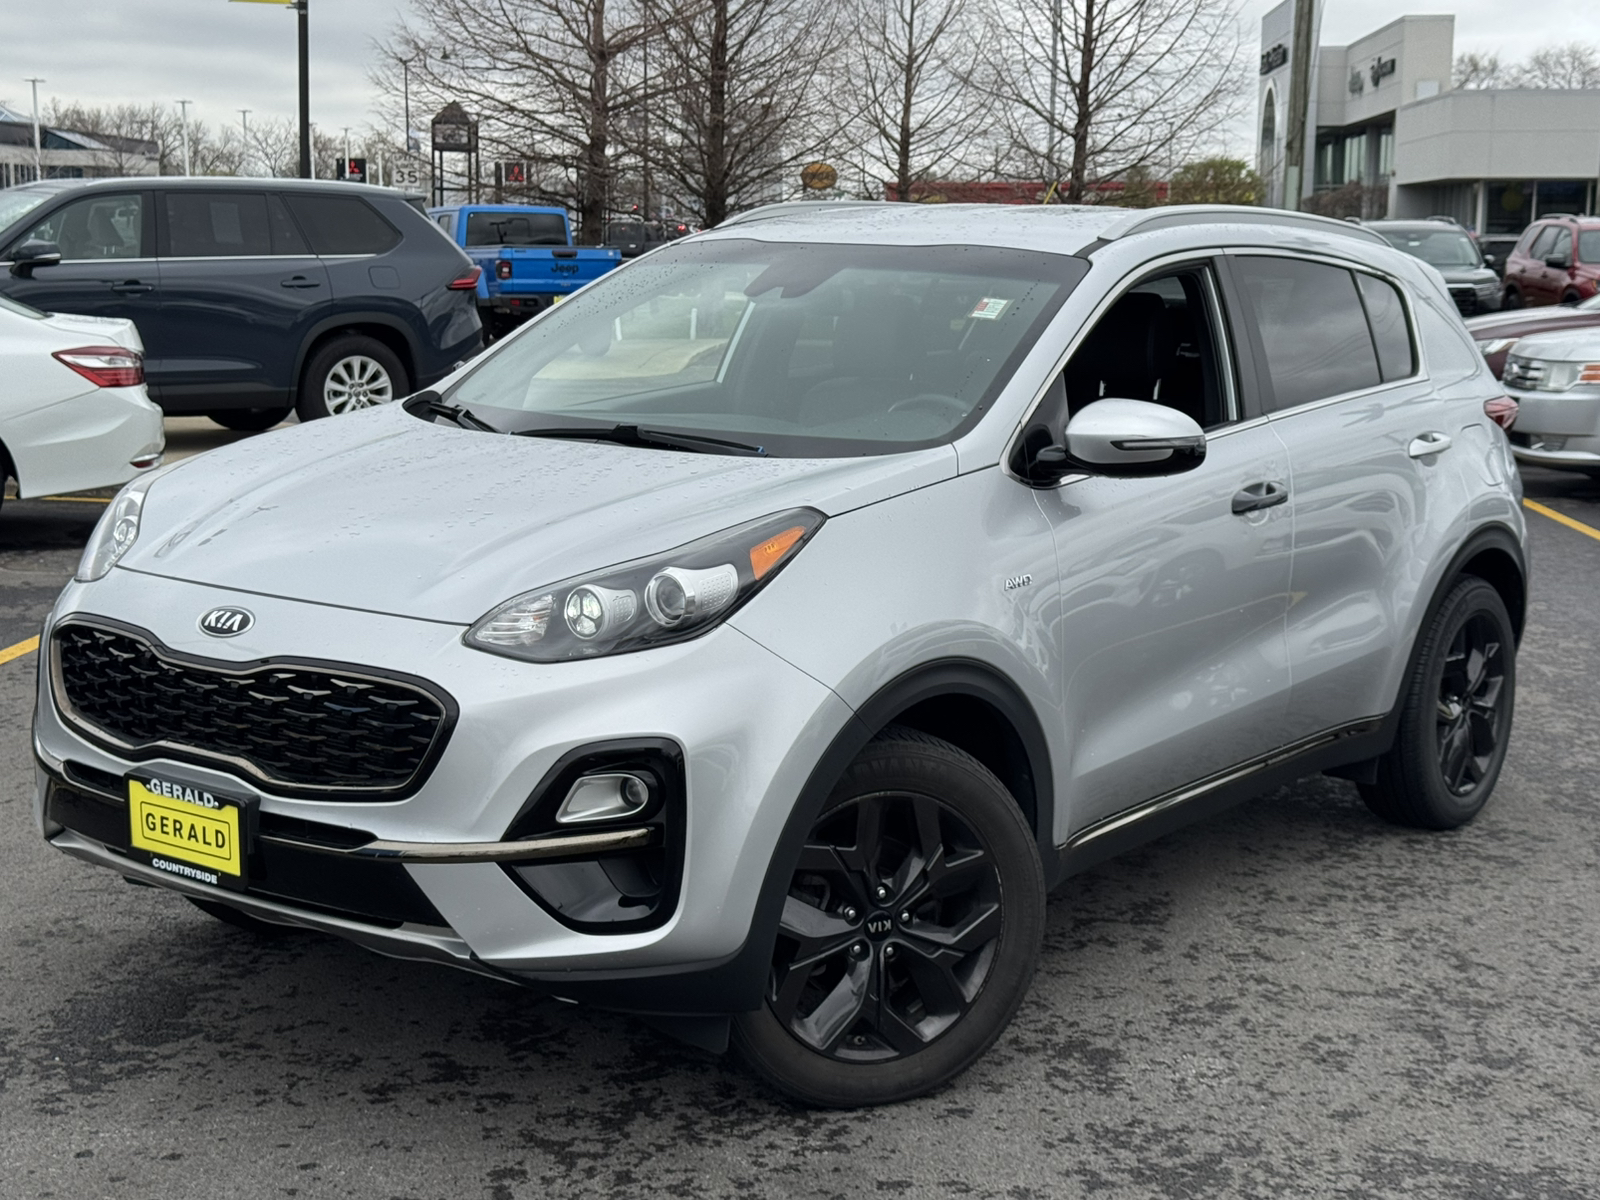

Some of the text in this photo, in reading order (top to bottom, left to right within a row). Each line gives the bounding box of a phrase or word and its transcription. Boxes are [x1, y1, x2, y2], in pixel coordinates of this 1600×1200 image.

[395, 170, 418, 184] 35
[551, 262, 579, 274] Jeep
[1004, 574, 1033, 591] AWD
[204, 610, 243, 632] KIA
[150, 778, 214, 808] GERALD
[145, 812, 226, 849] GERALD
[152, 858, 218, 884] COUNTRYSIDE
[867, 919, 892, 933] KIA
